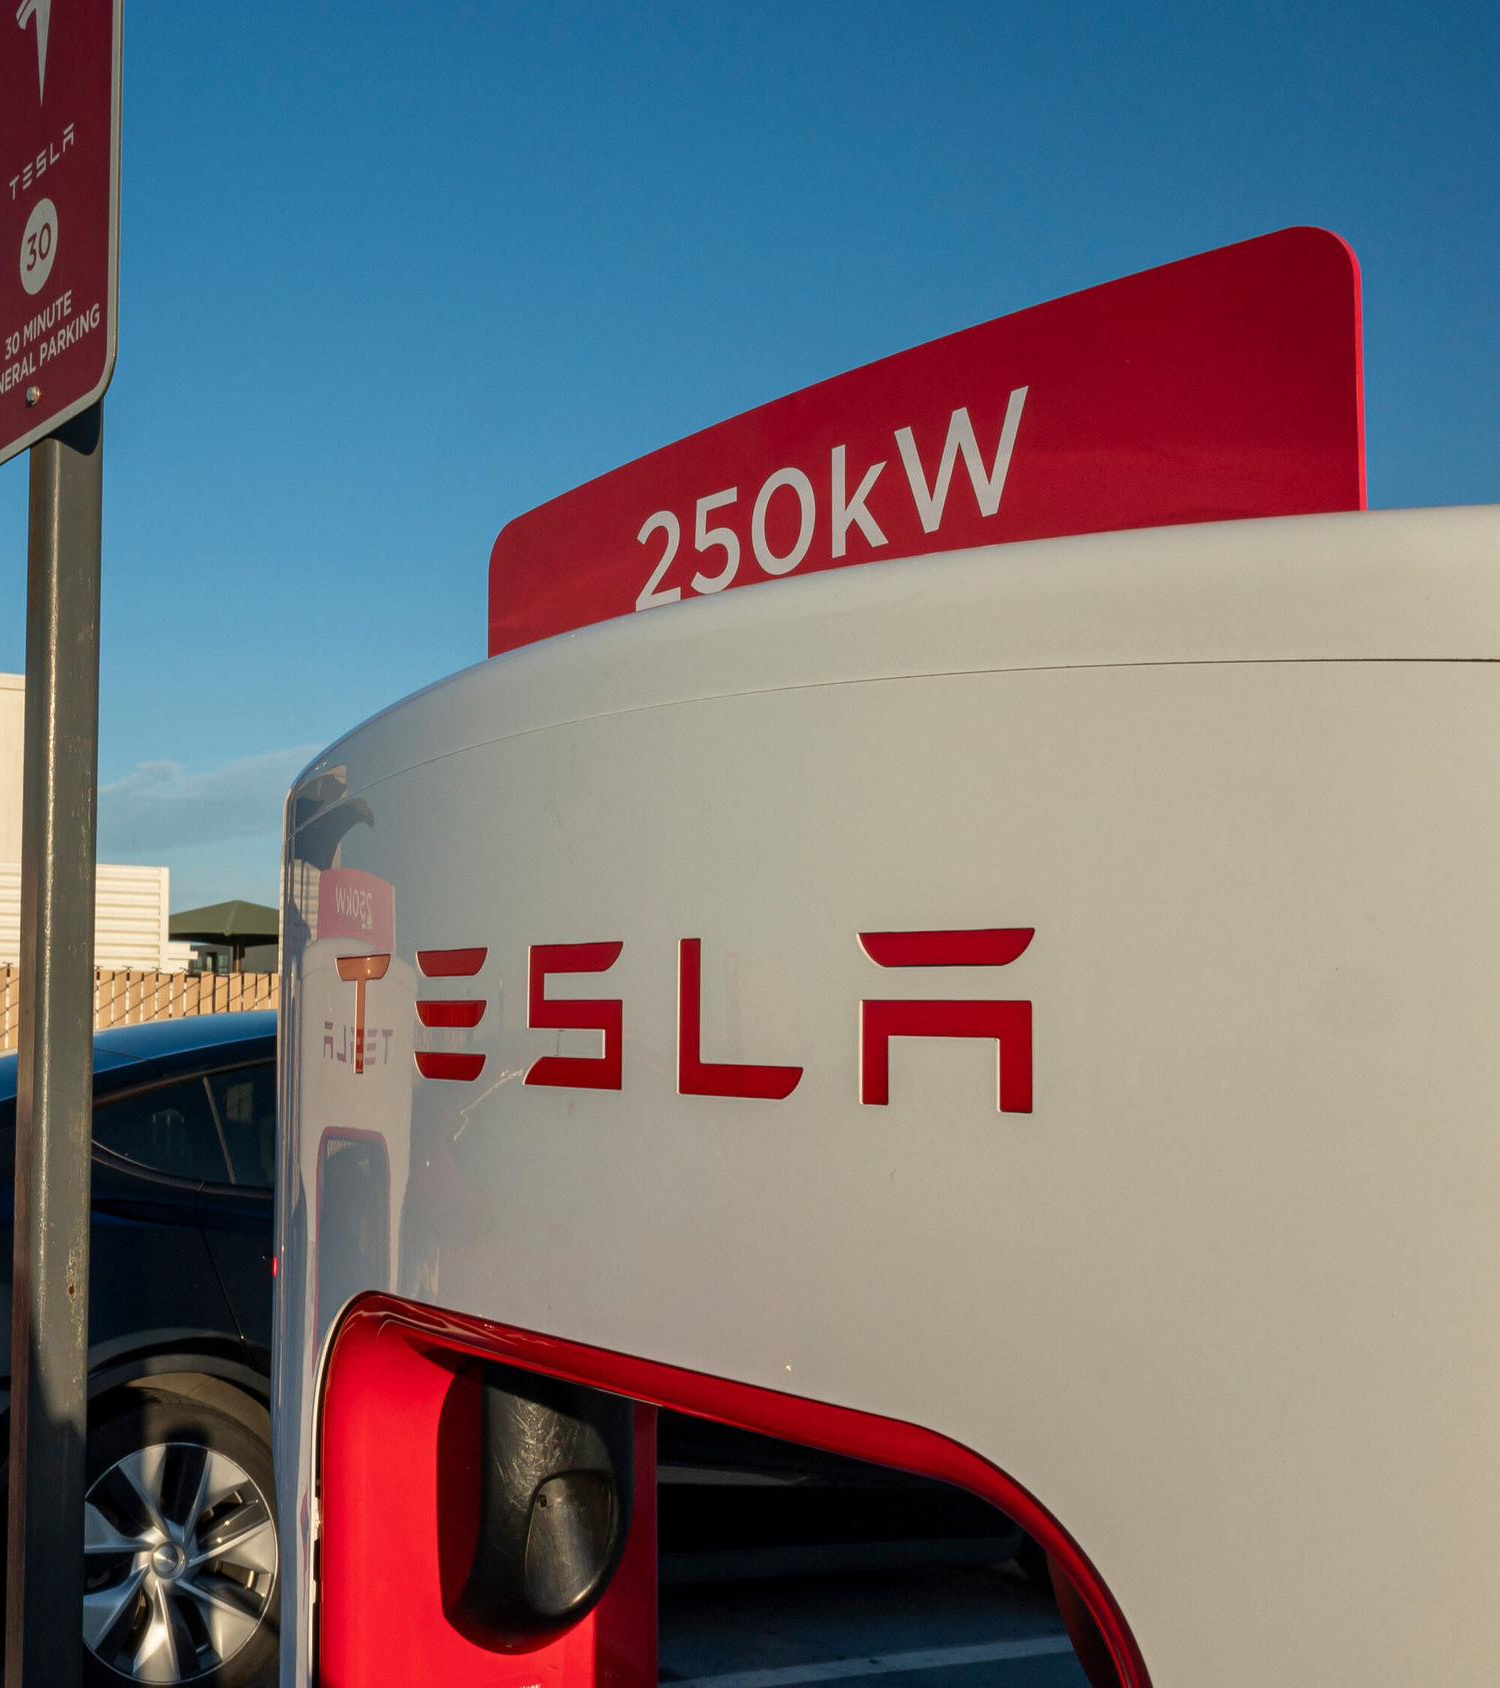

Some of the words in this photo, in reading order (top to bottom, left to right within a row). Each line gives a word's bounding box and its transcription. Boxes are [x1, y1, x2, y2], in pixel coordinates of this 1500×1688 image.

[8, 122, 75, 200] TESLA
[26, 222, 52, 272] 30
[5, 331, 20, 360] 30
[23, 289, 72, 347] MINUTE
[39, 303, 100, 367] PARKING
[635, 385, 1030, 612] 250kW
[336, 927, 1036, 1114] TESLA
